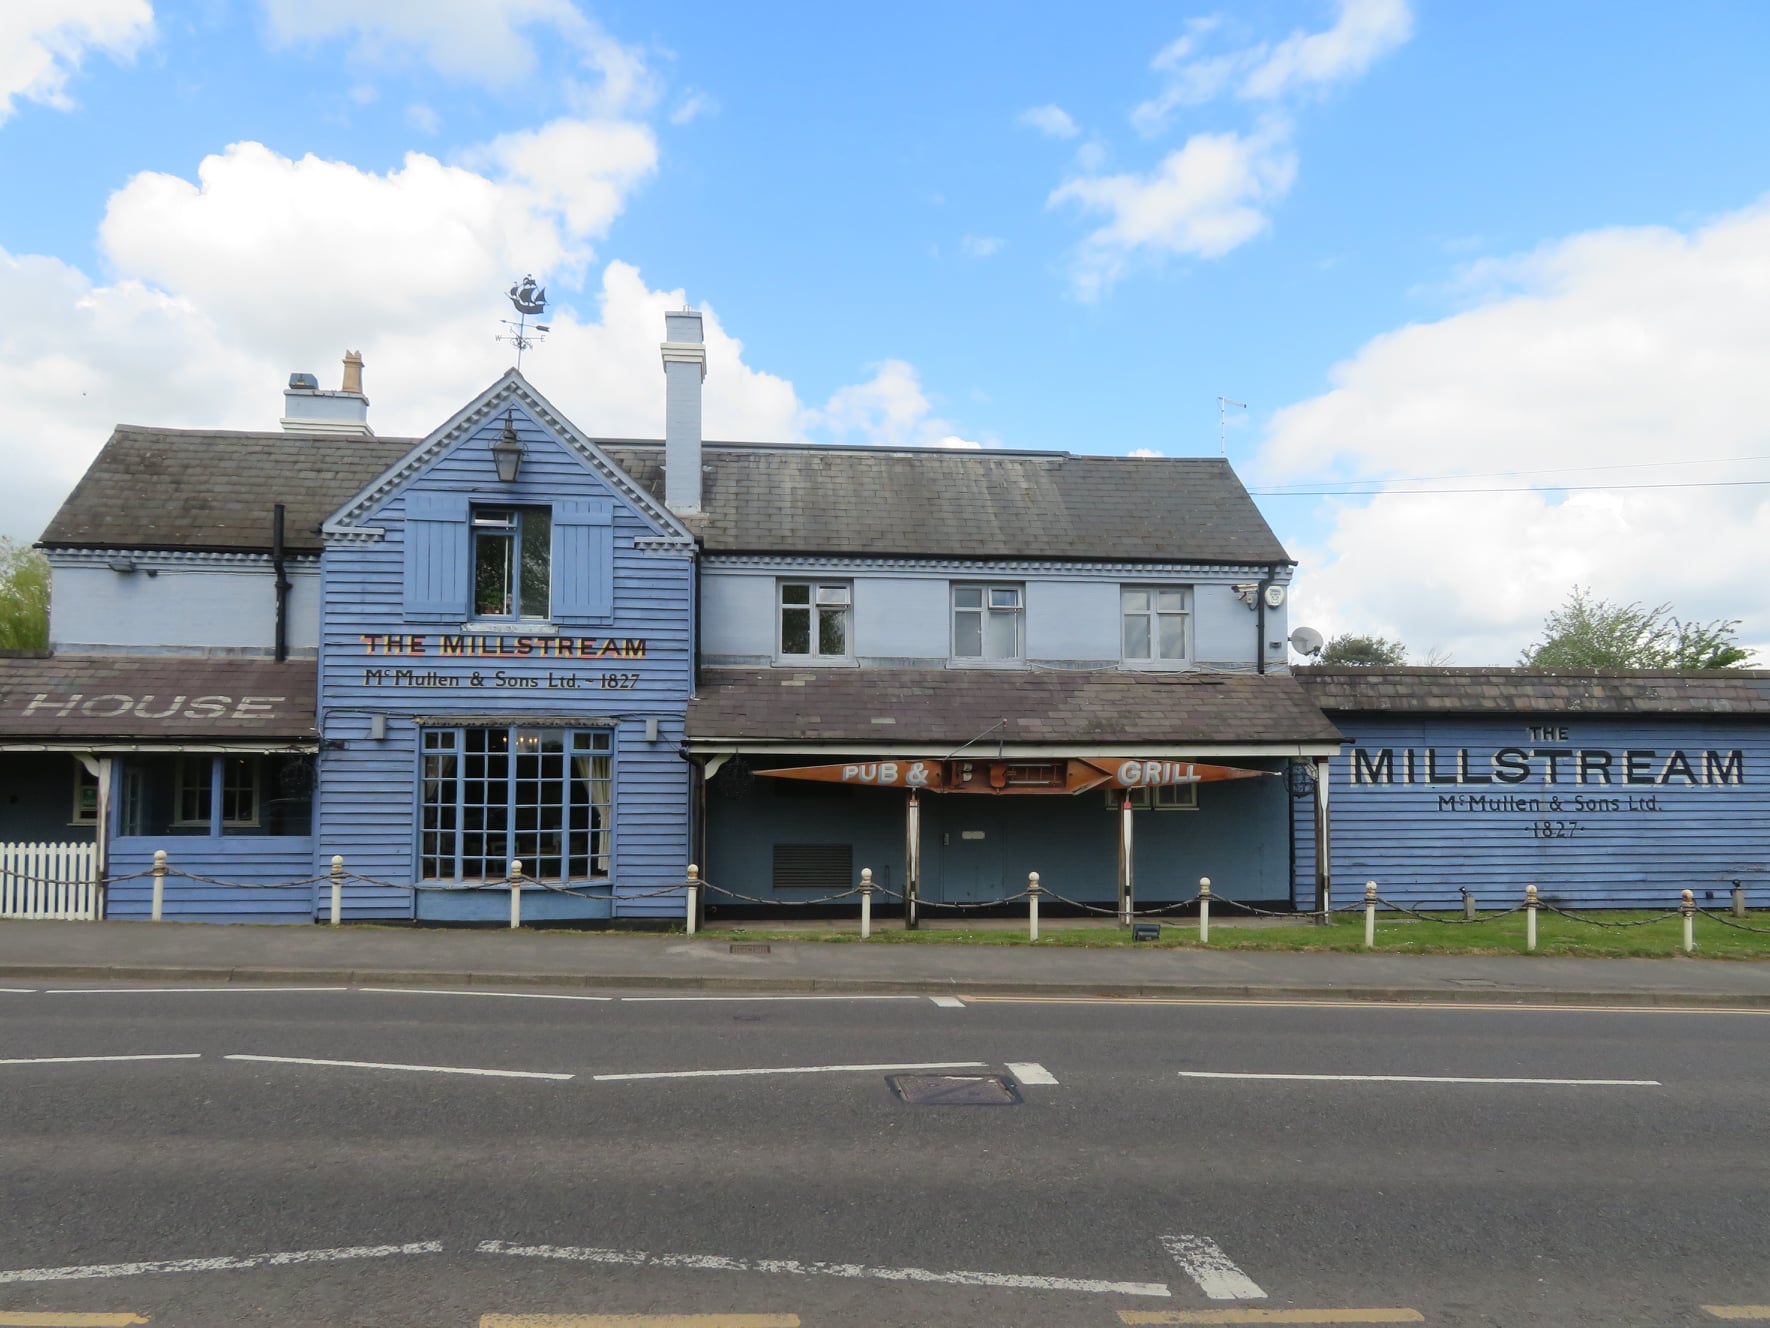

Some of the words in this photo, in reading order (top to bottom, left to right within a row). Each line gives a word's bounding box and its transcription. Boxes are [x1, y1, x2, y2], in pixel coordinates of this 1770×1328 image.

[361, 634, 426, 656] THE
[440, 635, 647, 660] MILLSTREAM
[363, 668, 459, 687] McMullen
[470, 672, 484, 687] &
[495, 671, 539, 688] Sons
[548, 672, 581, 689] Ltd.
[600, 673, 640, 689] 1827
[21, 693, 286, 718] HOUSE
[1527, 726, 1569, 741] THE
[842, 763, 898, 784] PUB
[905, 763, 929, 785] &
[1117, 761, 1202, 784] GRILL
[1350, 748, 1744, 788] MILLSTREAM
[1438, 795, 1540, 812] McMullen
[1549, 797, 1562, 811] &
[1575, 796, 1620, 812] Sons
[1629, 796, 1662, 812] Ltd.
